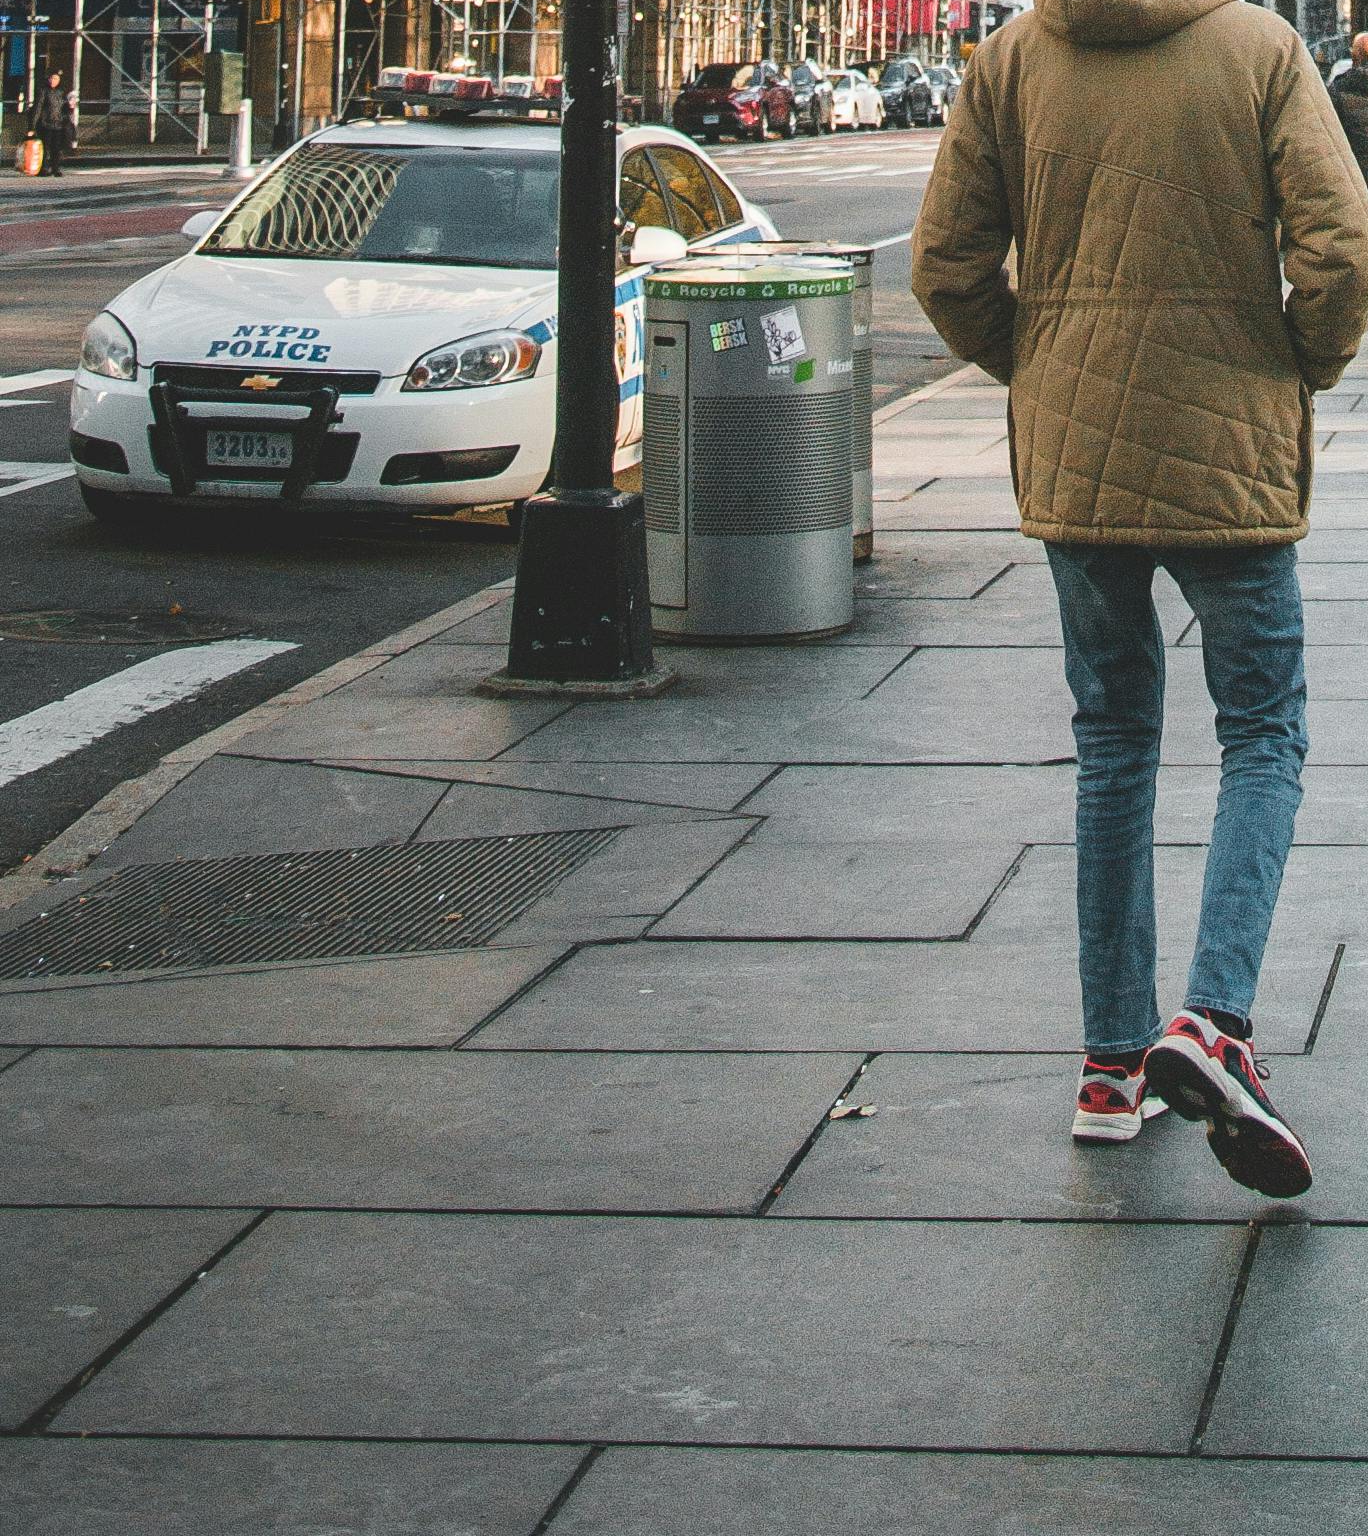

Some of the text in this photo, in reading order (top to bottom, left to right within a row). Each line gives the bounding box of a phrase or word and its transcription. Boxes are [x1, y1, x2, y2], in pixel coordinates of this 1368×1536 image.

[679, 284, 746, 298] Recycle
[788, 281, 841, 296] Recycle
[233, 325, 320, 340] NYPD
[206, 340, 332, 363] POLICE
[215, 434, 269, 458] 3203
